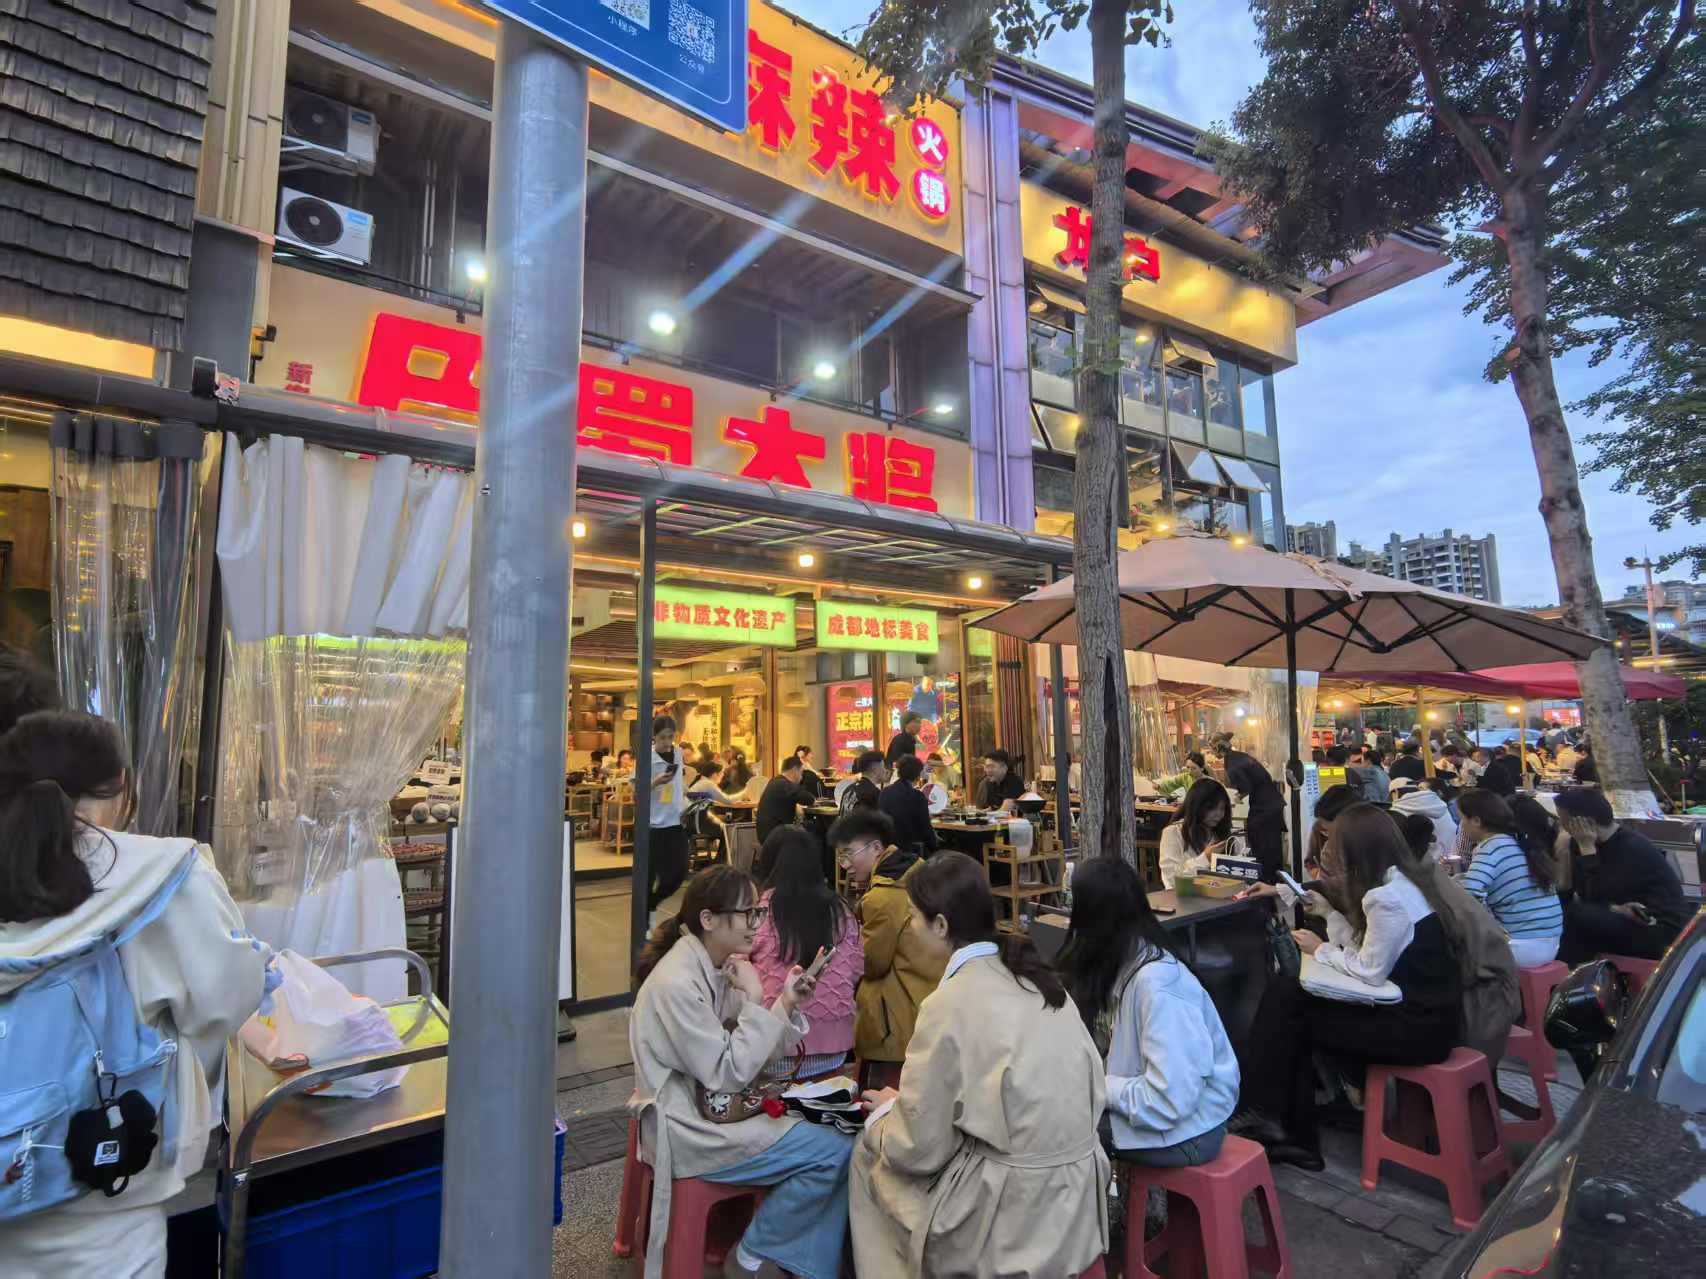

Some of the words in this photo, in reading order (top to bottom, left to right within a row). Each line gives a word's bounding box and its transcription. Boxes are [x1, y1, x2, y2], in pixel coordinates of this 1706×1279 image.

[654, 600, 786, 631] 非物质文化遗产
[828, 613, 930, 642] 成都地标美食
